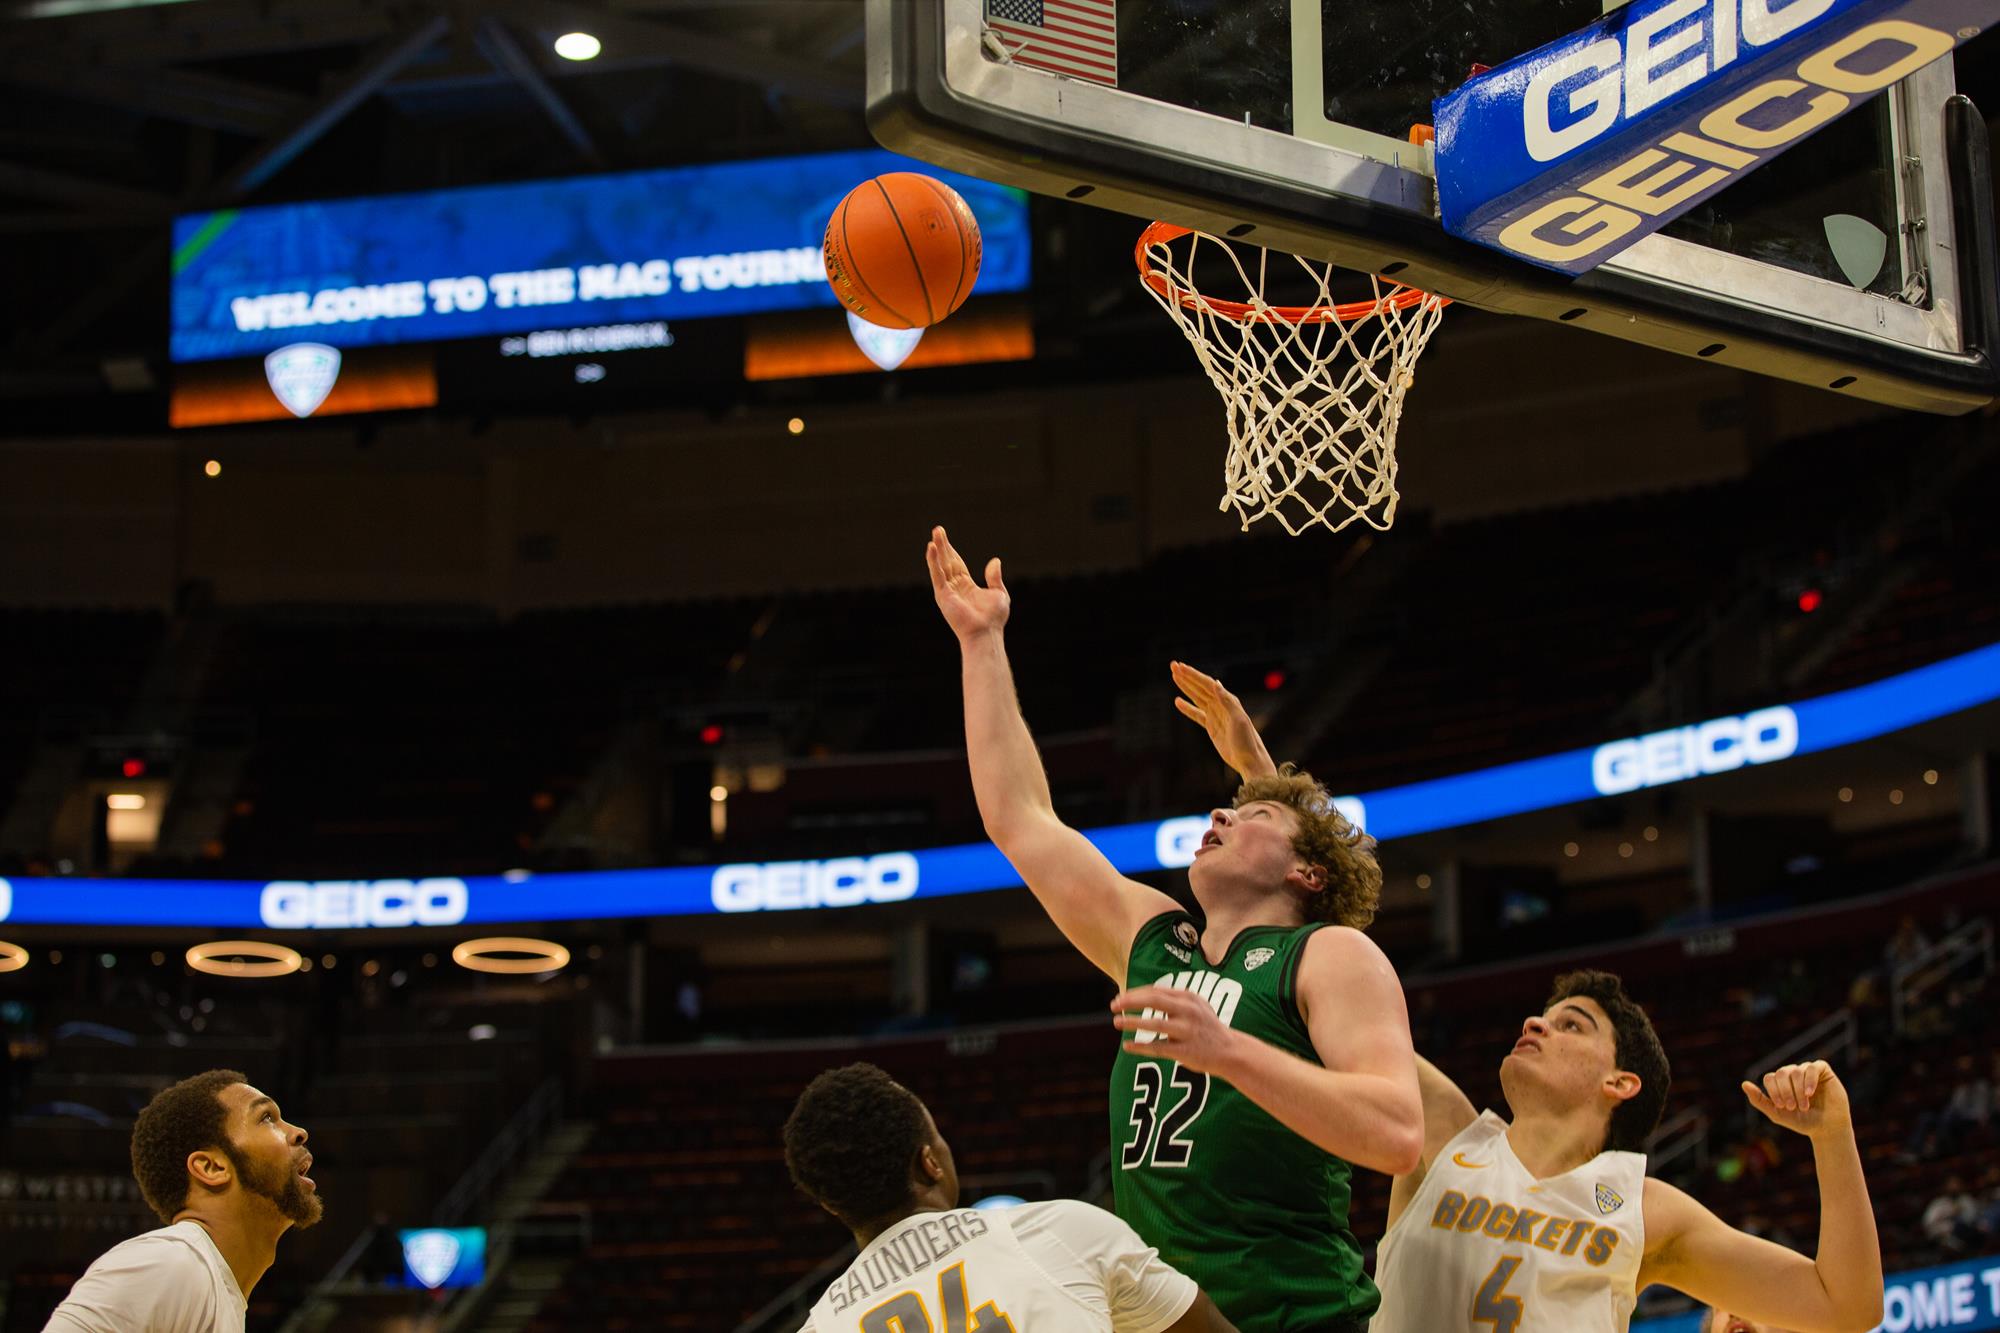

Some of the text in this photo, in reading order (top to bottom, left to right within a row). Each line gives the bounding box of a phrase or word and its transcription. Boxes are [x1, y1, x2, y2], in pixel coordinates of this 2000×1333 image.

[1498, 20, 1955, 262] GEICO
[231, 281, 426, 331] WELCOME
[428, 275, 487, 313] TO
[489, 268, 575, 308] THE
[578, 259, 671, 300] MAC
[1592, 705, 1798, 795] GEICO
[260, 877, 468, 929] GEICO
[711, 851, 919, 912] GEICO
[1122, 1060, 1210, 1170] 32
[828, 1211, 989, 1316] SAUNDERS
[1431, 1190, 1619, 1267] ROCKETS
[1472, 1253, 1524, 1333] 4
[1870, 1272, 1977, 1333] OME
